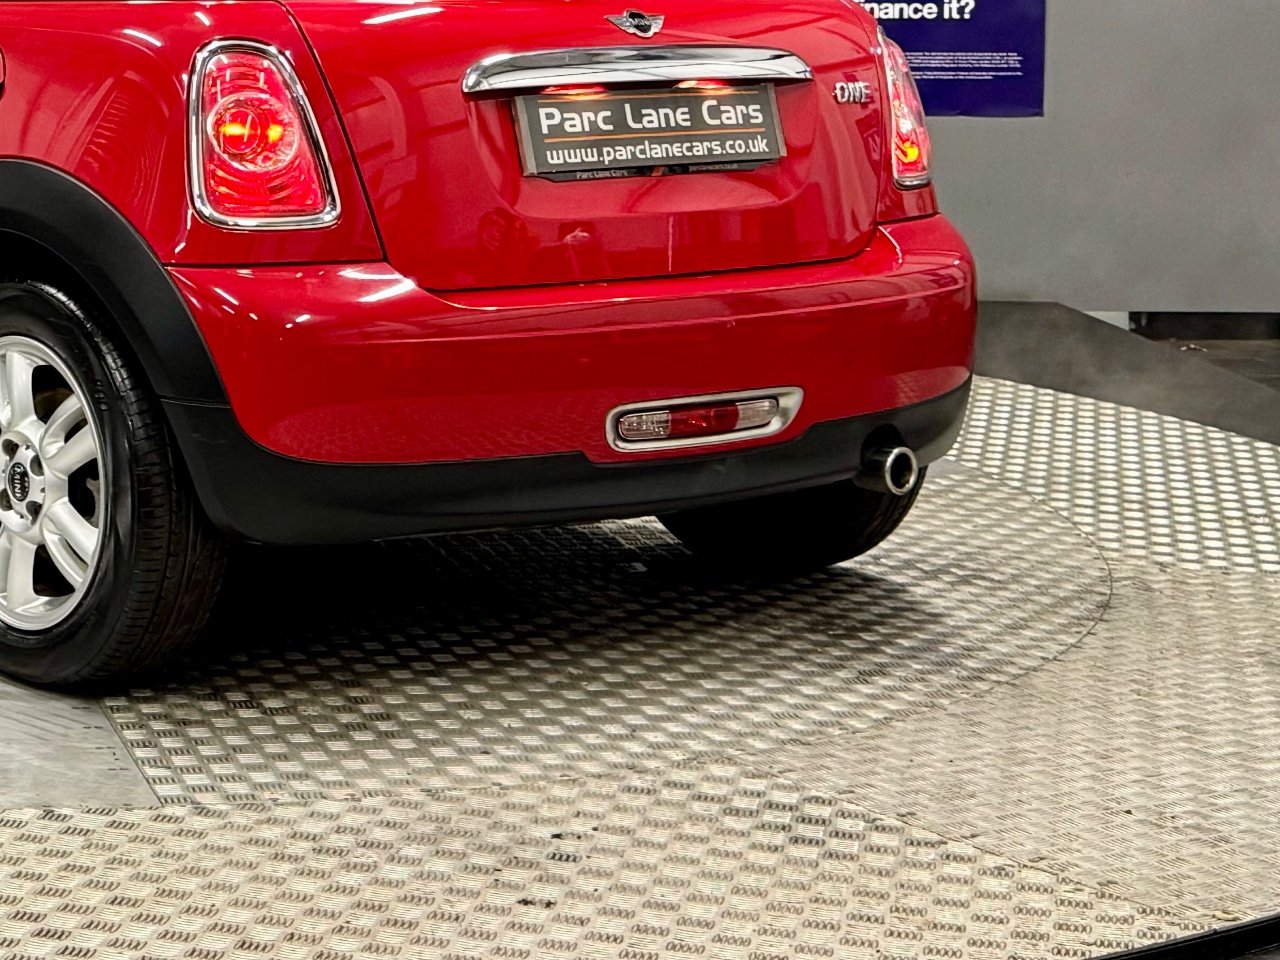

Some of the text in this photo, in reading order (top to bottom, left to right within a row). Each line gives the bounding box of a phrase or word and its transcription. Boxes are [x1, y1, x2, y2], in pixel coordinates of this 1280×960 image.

[834, 81, 871, 103] ONE
[538, 99, 763, 134] Parc Lane Cars
[546, 134, 769, 165] www.parclanecars.co.uk
